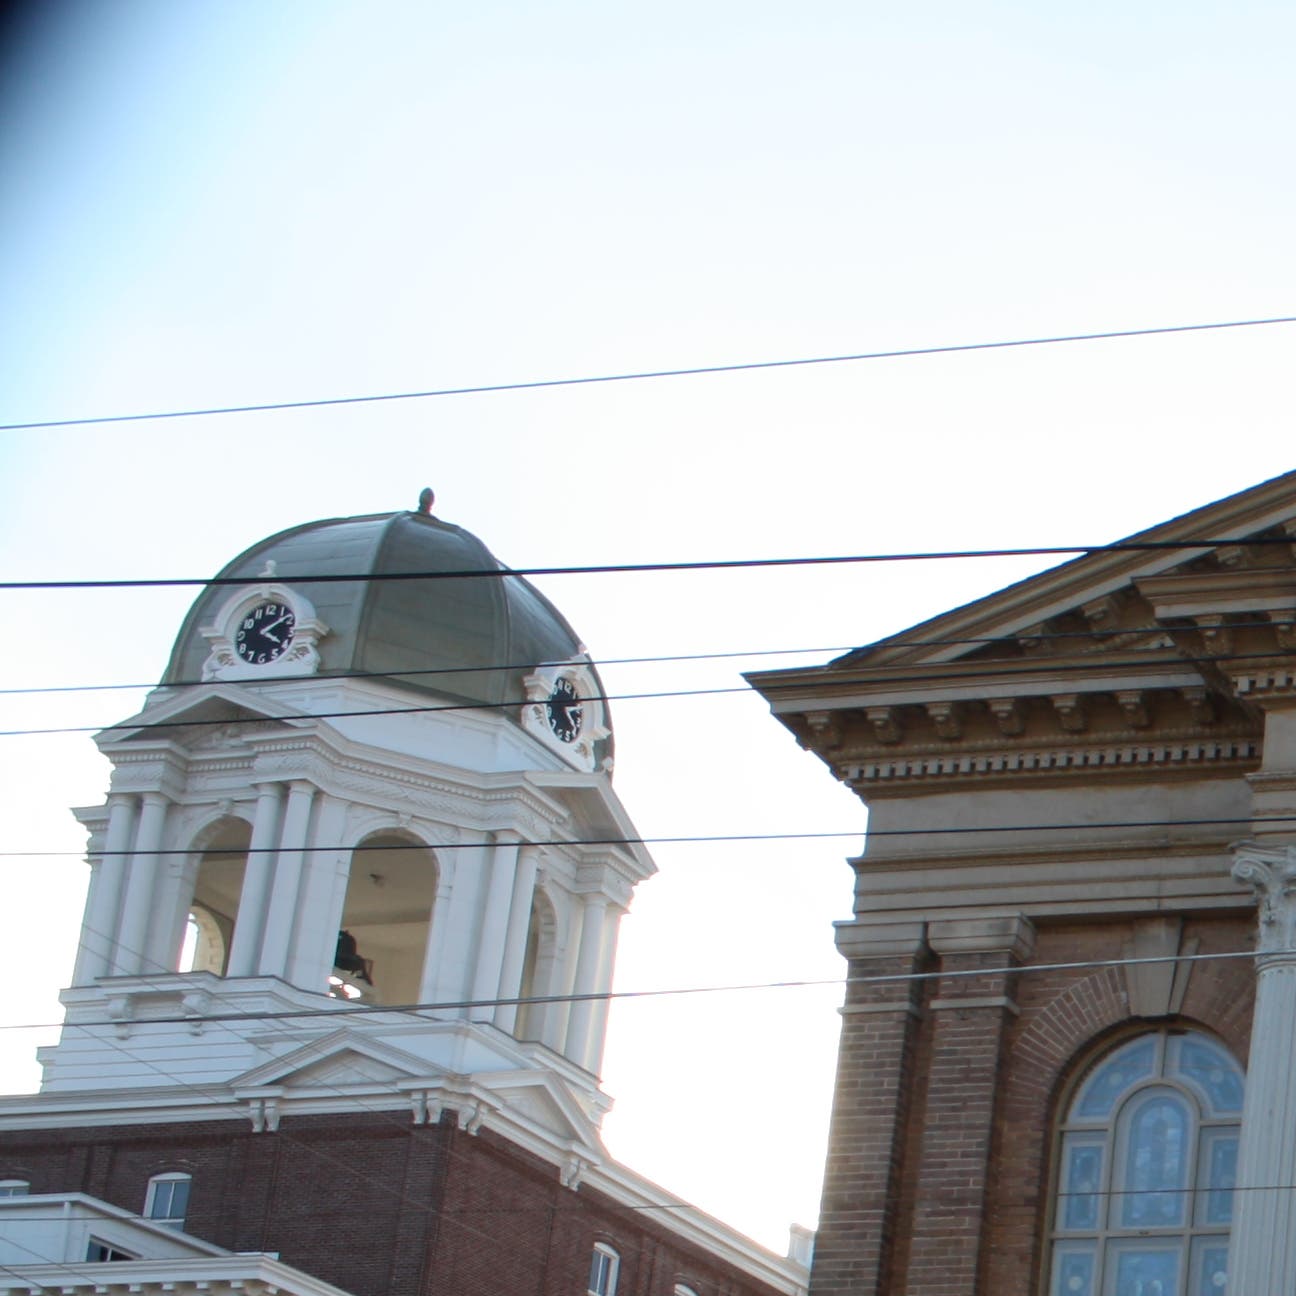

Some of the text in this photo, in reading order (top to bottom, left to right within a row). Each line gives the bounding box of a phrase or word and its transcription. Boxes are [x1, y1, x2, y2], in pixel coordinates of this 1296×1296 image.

[255, 608, 263, 620] 11
[265, 604, 277, 616] 12
[280, 606, 285, 617] 1
[243, 618, 255, 630] 10
[285, 614, 294, 625] 2
[237, 630, 246, 641] 9
[239, 643, 247, 654] 8
[271, 648, 279, 659] 5
[247, 650, 255, 662] 7
[257, 652, 266, 664] 6
